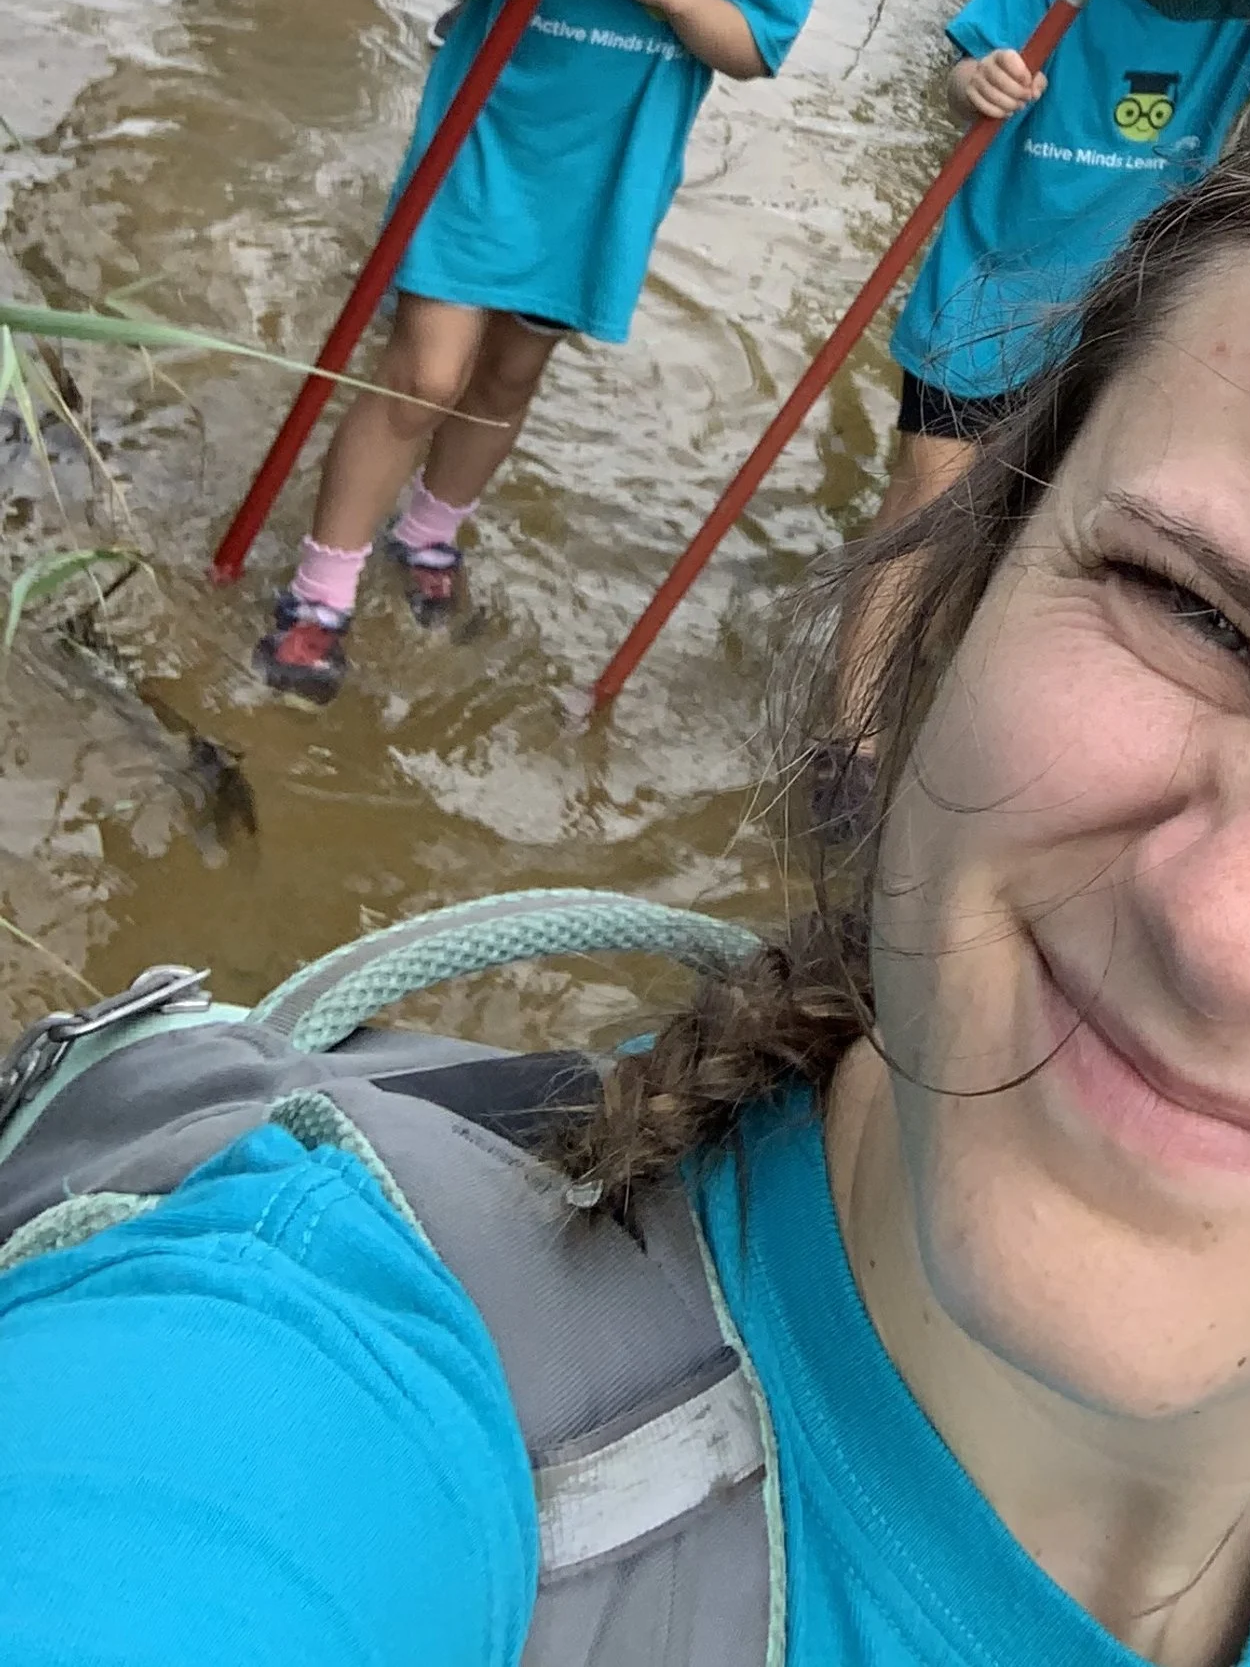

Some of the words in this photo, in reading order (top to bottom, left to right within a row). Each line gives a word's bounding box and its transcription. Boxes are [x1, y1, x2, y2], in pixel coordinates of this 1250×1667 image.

[530, 14, 587, 43] Active
[590, 27, 643, 52] Minds
[1023, 138, 1073, 162] Active
[1076, 148, 1123, 169] Minds
